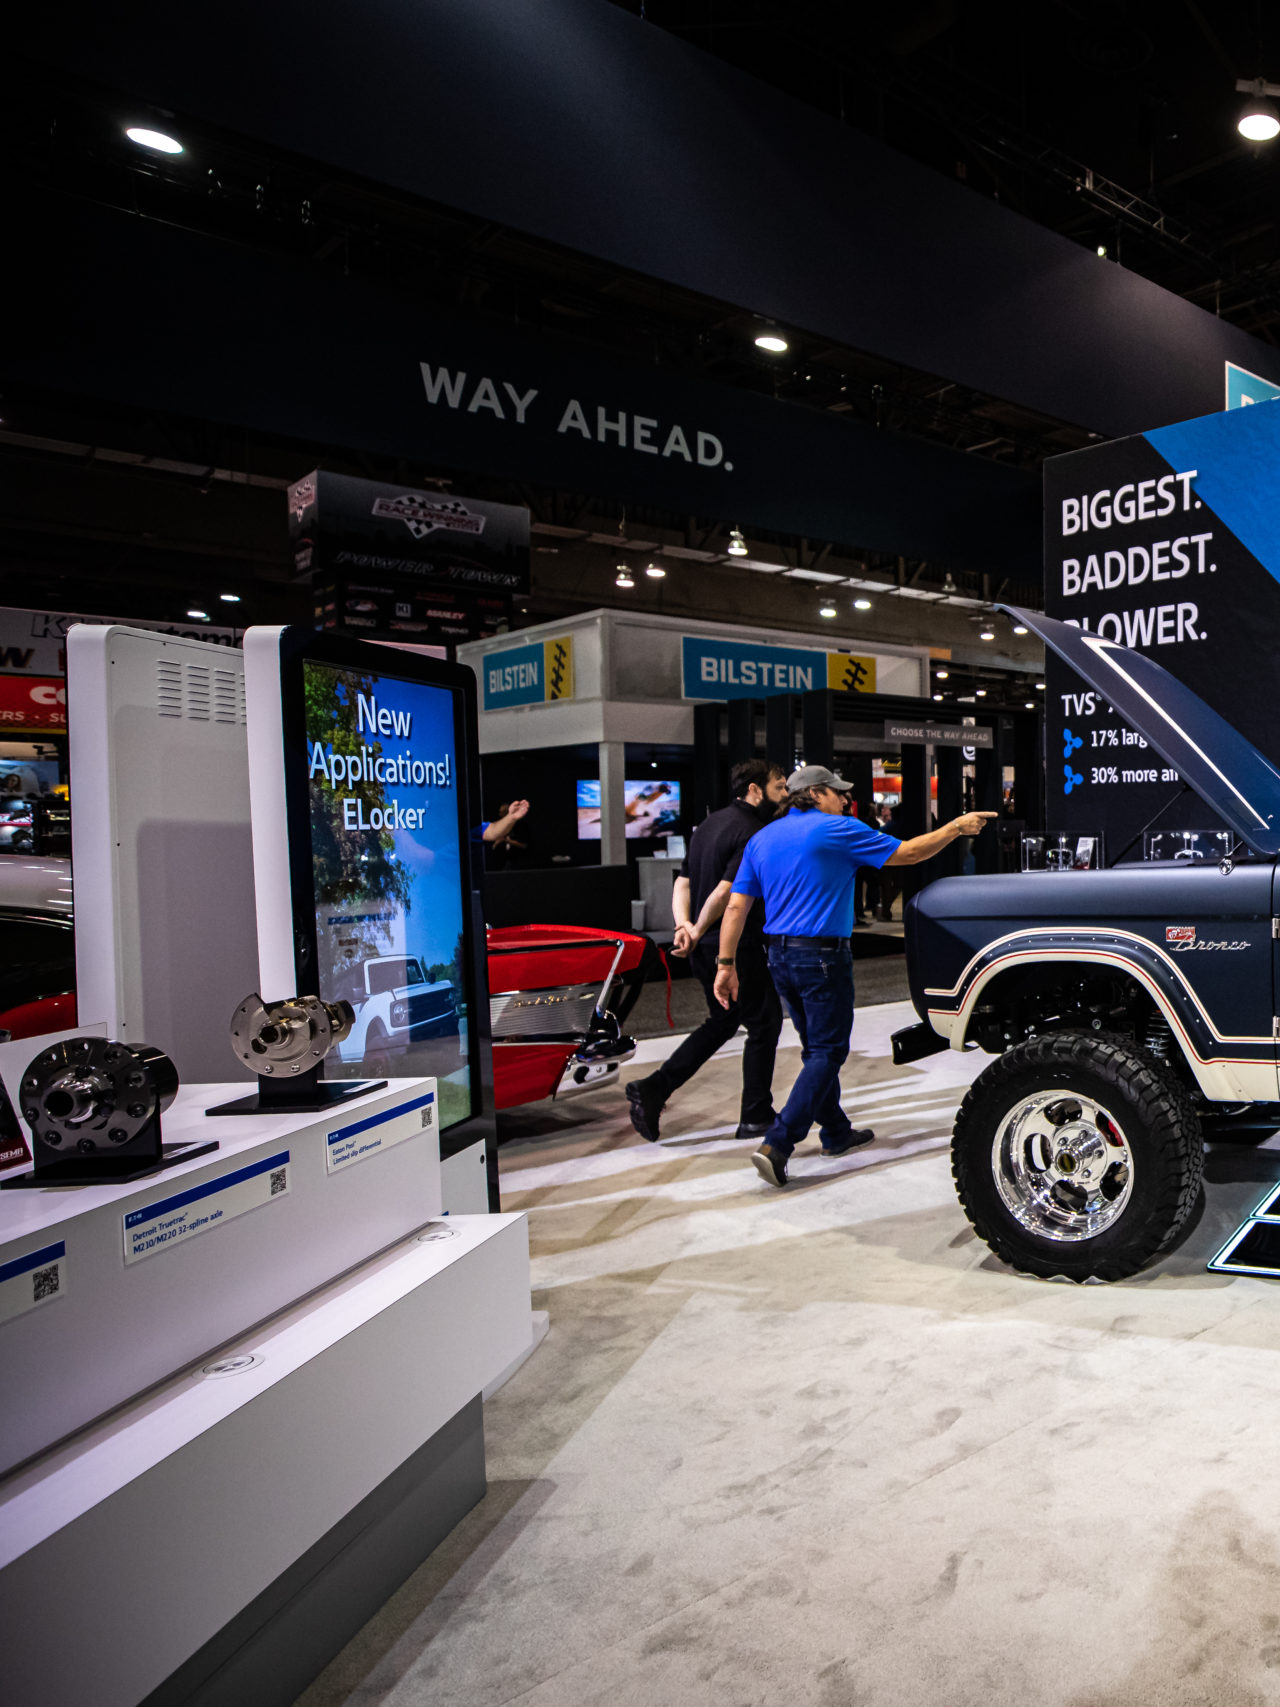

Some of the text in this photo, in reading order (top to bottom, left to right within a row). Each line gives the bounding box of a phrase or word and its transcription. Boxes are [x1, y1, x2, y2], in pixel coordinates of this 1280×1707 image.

[420, 362, 733, 471] WAY AHEAD.
[378, 503, 420, 516] RACE
[1062, 470, 1201, 536] BIGGEST.
[1063, 532, 1217, 597] BADDEST.
[489, 661, 539, 694] BILSTEIN
[700, 656, 813, 690] BILSTEIN
[357, 693, 411, 737] New
[891, 727, 988, 741] CHOOSE THE WAY AHEAD
[1091, 729, 1119, 748] 17%
[309, 741, 450, 790] Applications!
[1091, 767, 1119, 785] 30%
[1121, 769, 1158, 783] more
[343, 798, 425, 831] ELocker
[1170, 935, 1251, 951] Bronco
[132, 1226, 157, 1242] Detroit
[133, 1209, 224, 1255] M210/M220 32-spline axle
